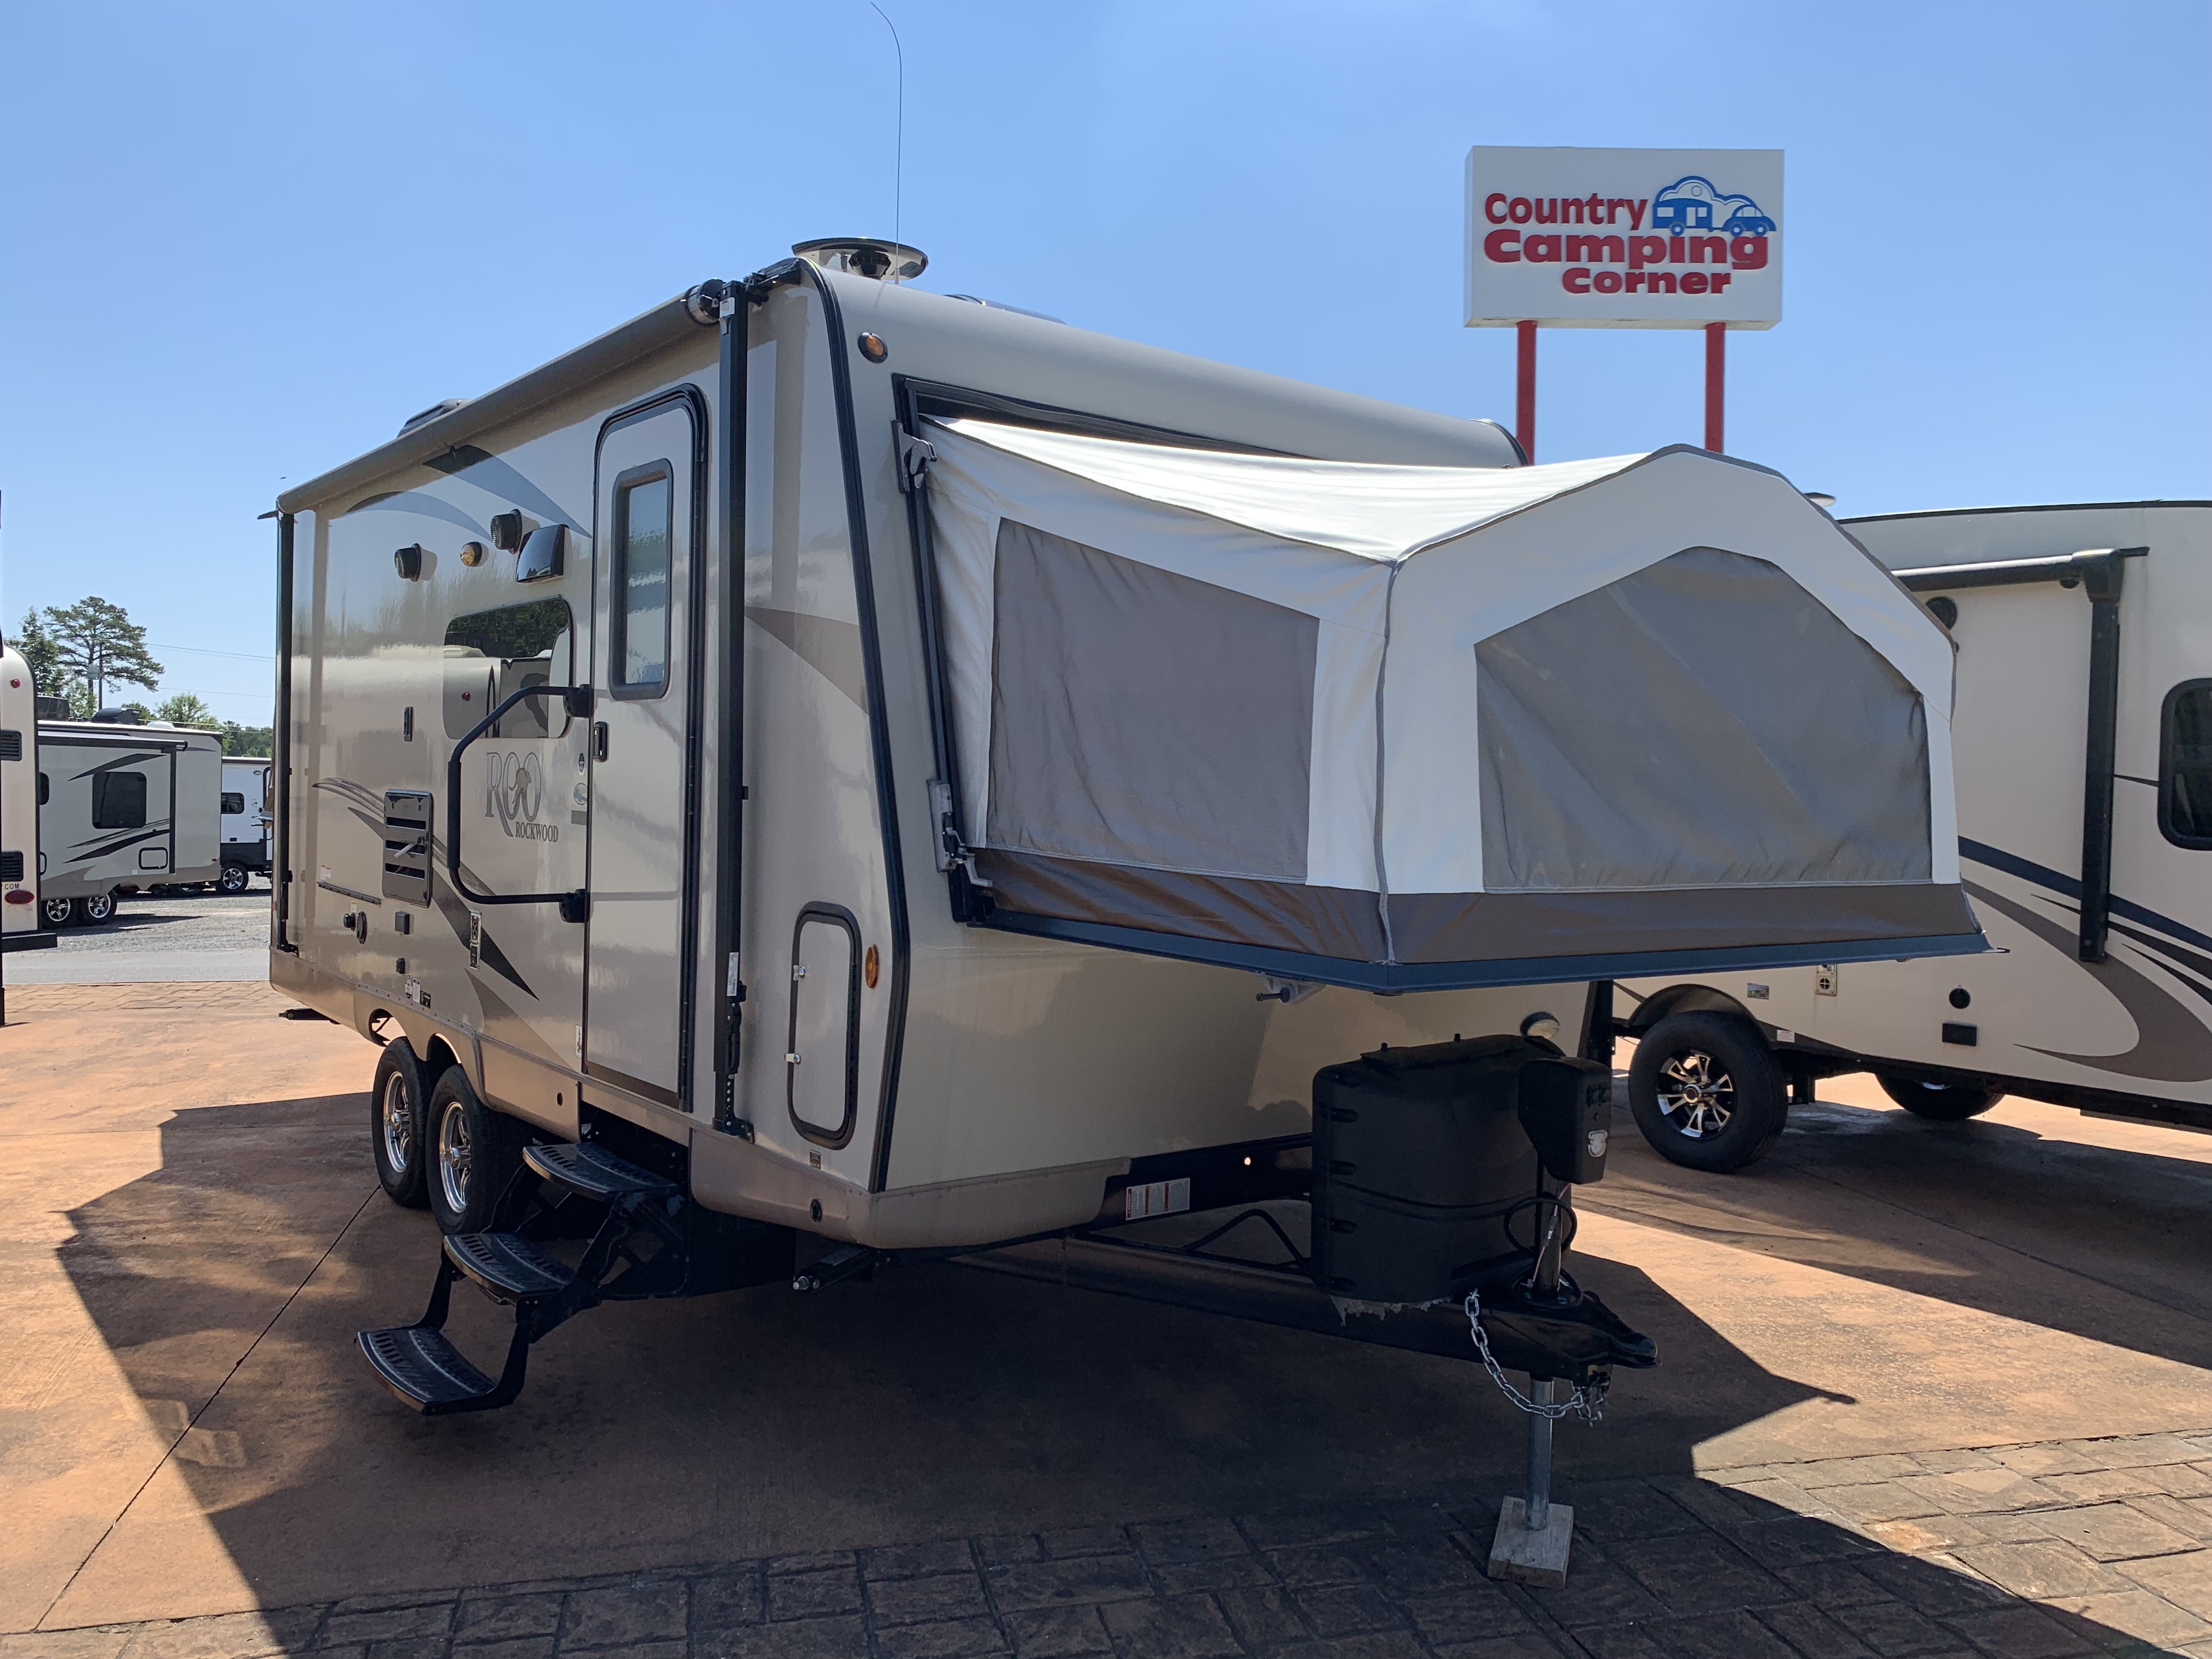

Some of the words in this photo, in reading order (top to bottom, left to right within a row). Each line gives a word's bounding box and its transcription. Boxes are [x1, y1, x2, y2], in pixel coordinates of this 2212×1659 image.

[1485, 193, 1649, 230] Country
[1484, 229, 1768, 270] Camping
[1561, 267, 1731, 294] Corner
[485, 752, 541, 837] ROO
[515, 821, 558, 843] ROCKWOOD
